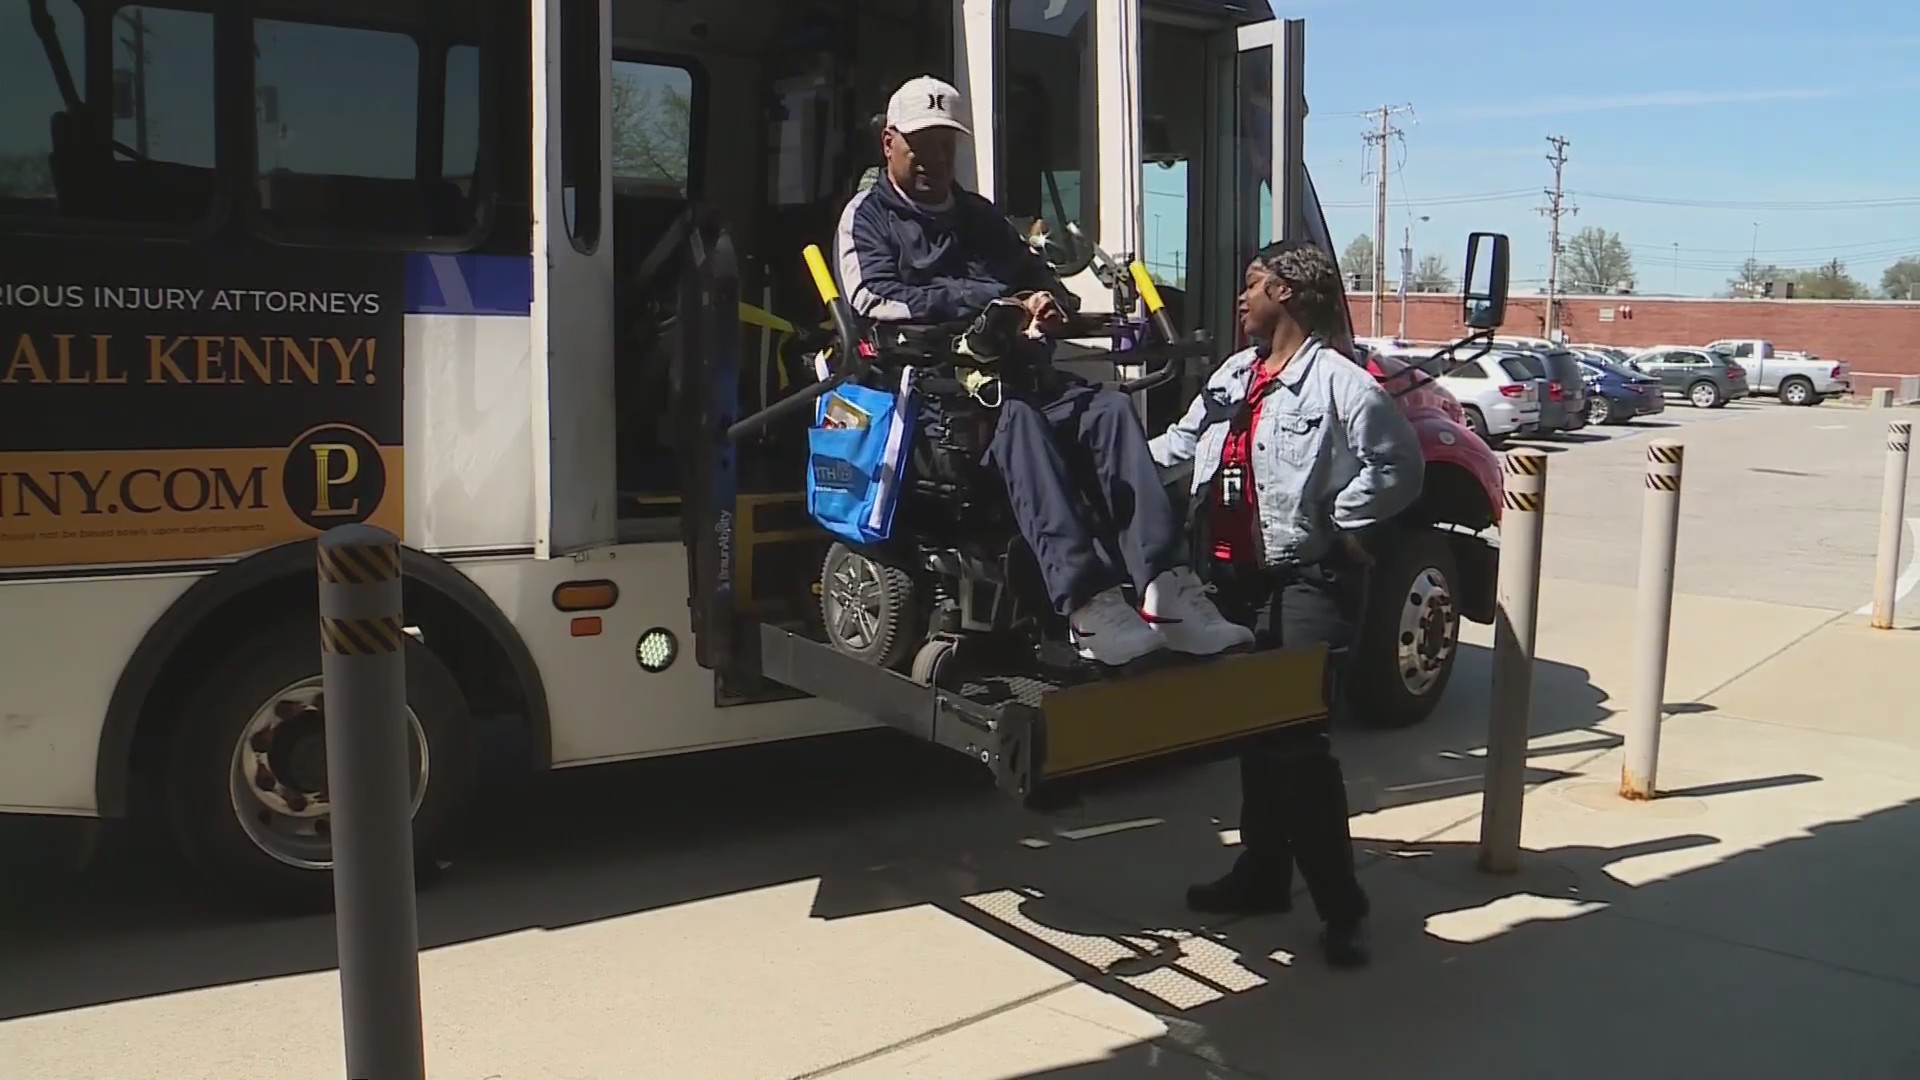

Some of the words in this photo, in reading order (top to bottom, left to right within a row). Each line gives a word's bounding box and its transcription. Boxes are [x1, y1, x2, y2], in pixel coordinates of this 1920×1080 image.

[0, 284, 84, 308] IOUS
[94, 286, 204, 310] INJURY
[211, 289, 380, 314] ATTORNEYS
[2, 333, 128, 384] ALL
[144, 335, 376, 385] KENNY!
[0, 466, 269, 517] NY.COM
